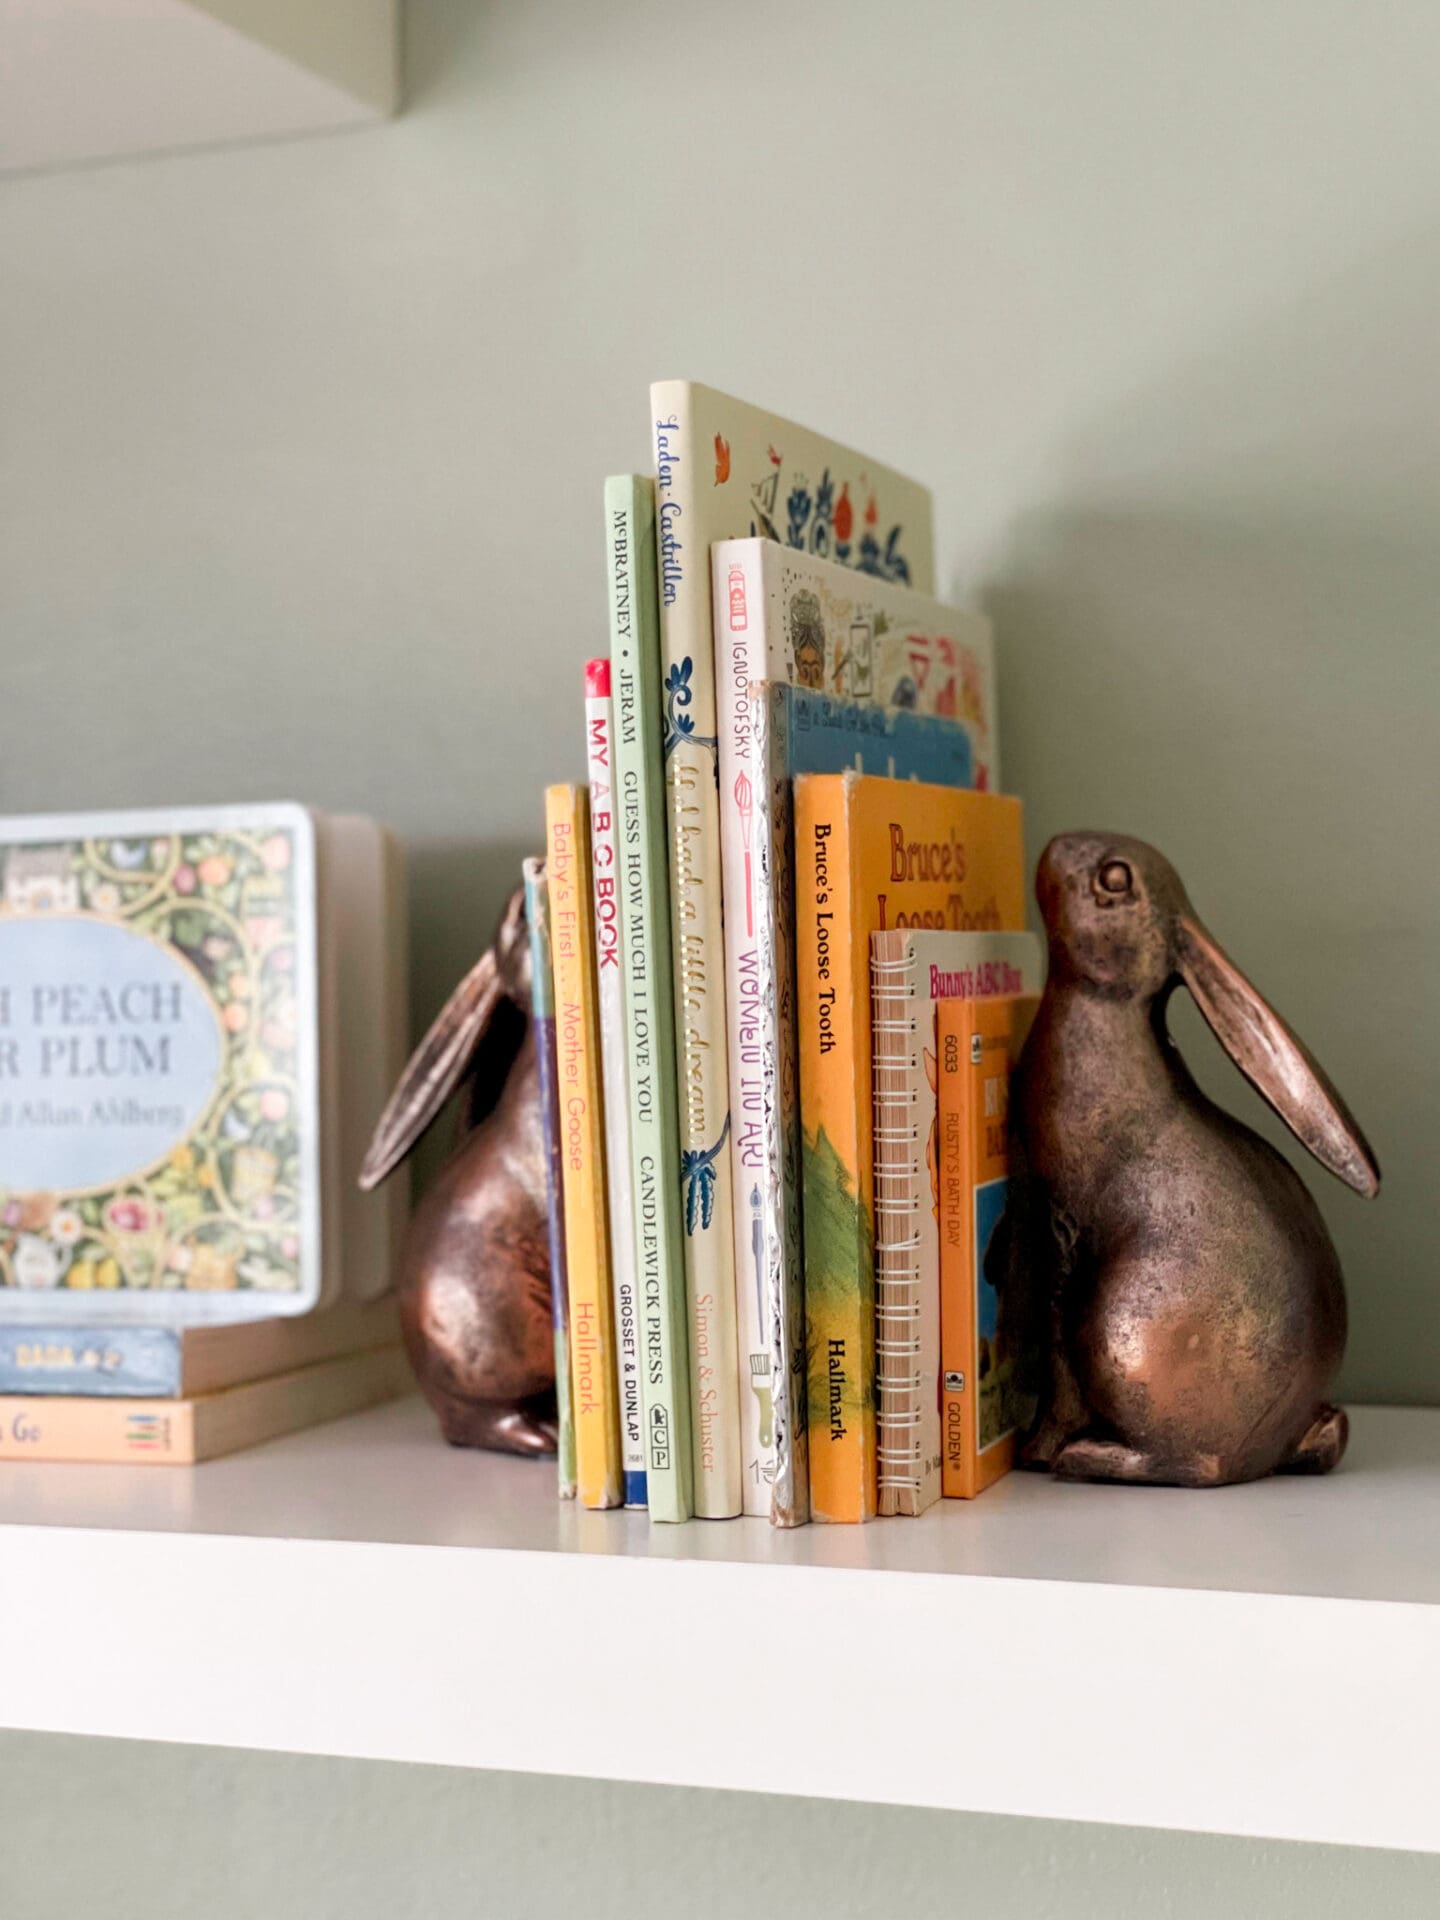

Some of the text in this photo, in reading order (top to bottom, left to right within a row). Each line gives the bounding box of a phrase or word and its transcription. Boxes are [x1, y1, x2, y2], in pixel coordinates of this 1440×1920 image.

[656, 415, 683, 606] Laden Castrillon
[620, 669, 637, 744] JERAM
[733, 642, 751, 759] IGNOTOFSKY
[589, 719, 609, 766] MY
[591, 779, 609, 801] A
[624, 772, 641, 844] GUESS
[552, 823, 572, 899] Baby's
[594, 844, 613, 868] C
[627, 853, 643, 908] HOW
[889, 823, 967, 883] Bruce's
[597, 877, 619, 970] BOOK
[630, 914, 647, 982] MUCH
[815, 823, 837, 1055] Bruce's Loose Tooth
[32, 981, 183, 1026] PEACH
[929, 963, 973, 999] Bunny's
[39, 1034, 171, 1079] PLUM
[563, 1002, 585, 1088] Mother
[634, 1008, 650, 1067] LOVE
[945, 1034, 958, 1073] 6033
[567, 1097, 587, 1172] Goose
[637, 1076, 653, 1124] YOU
[947, 1180, 960, 1218] BATH
[947, 1222, 961, 1248] DAY
[640, 1156, 664, 1385] CANDLEWICK PRESS
[576, 1303, 600, 1415] Hallmark
[619, 1284, 640, 1442] GROSSET & DUNLAP
[696, 1293, 719, 1472] Simon & Schuster
[828, 1339, 847, 1441] Hallmark
